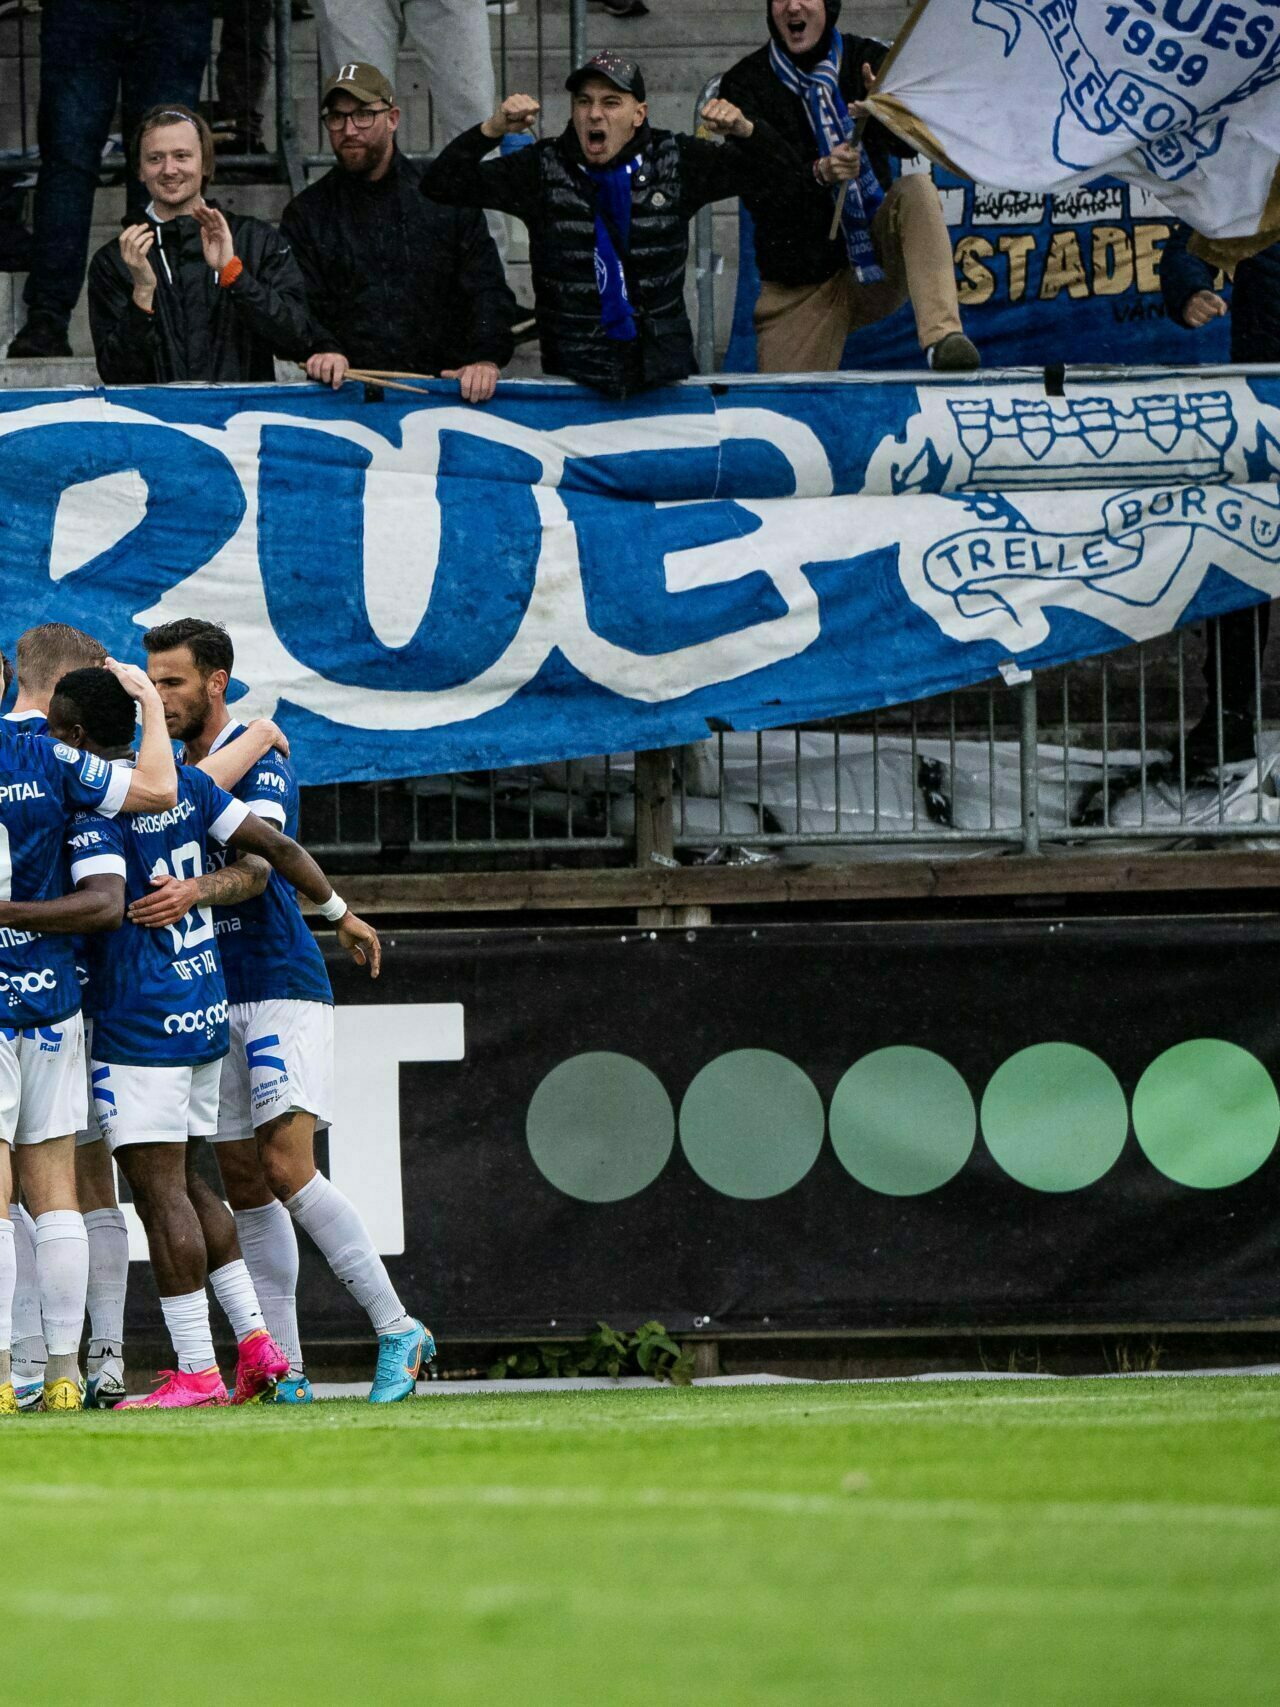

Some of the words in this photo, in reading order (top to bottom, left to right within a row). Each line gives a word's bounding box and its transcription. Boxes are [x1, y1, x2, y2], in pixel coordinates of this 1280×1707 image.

[1105, 5, 1208, 87] 1999
[1138, 0, 1274, 59] UES
[936, 538, 1109, 578] TRELLE
[1118, 486, 1243, 532] BORG
[172, 949, 218, 981] OFFIA
[39, 1042, 61, 1053] Rail
